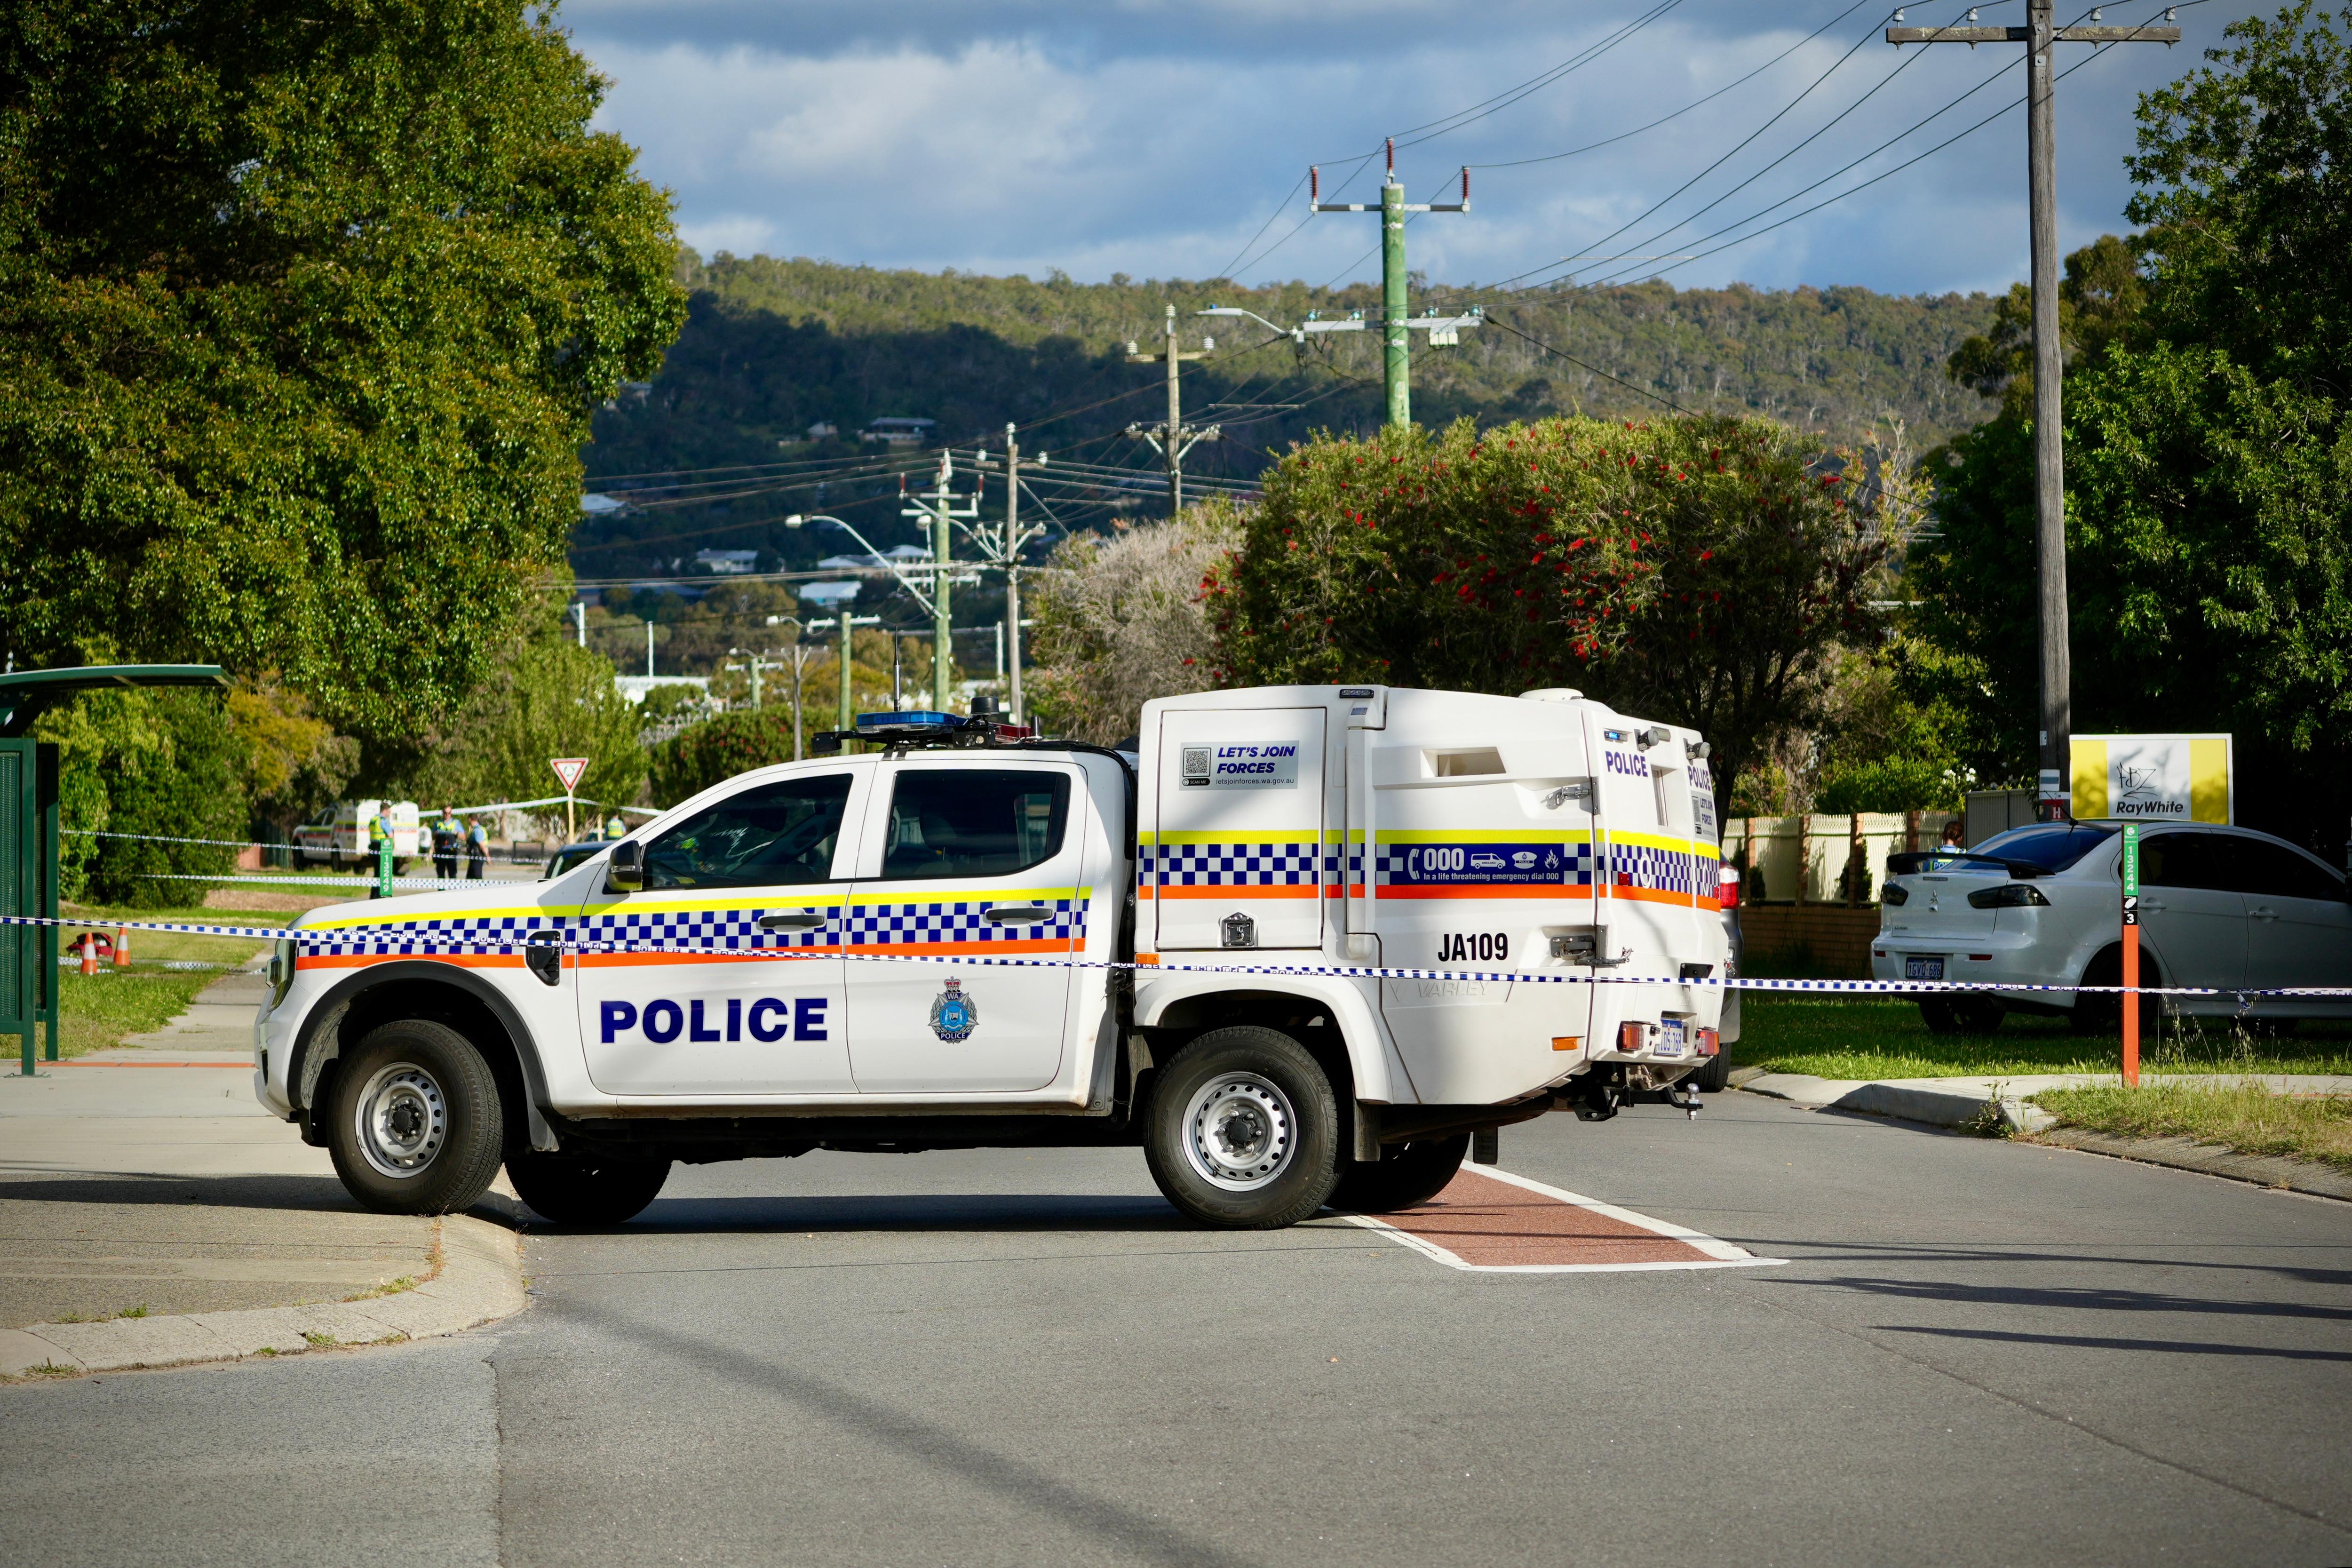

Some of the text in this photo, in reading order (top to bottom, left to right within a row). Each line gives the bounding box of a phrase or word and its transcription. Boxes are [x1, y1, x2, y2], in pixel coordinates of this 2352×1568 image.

[1217, 746, 1295, 757] LET'S JOIN
[1217, 762, 1275, 773] FORCES
[1605, 751, 1648, 777] POLICE
[1687, 765, 1711, 791] POLICE
[2053, 806, 2061, 819] H
[1424, 848, 1464, 870] 000
[2127, 913, 2134, 923] 3
[1438, 933, 1508, 962] JA109
[1418, 980, 1488, 998] VARLEY
[600, 997, 828, 1044] POLICE
